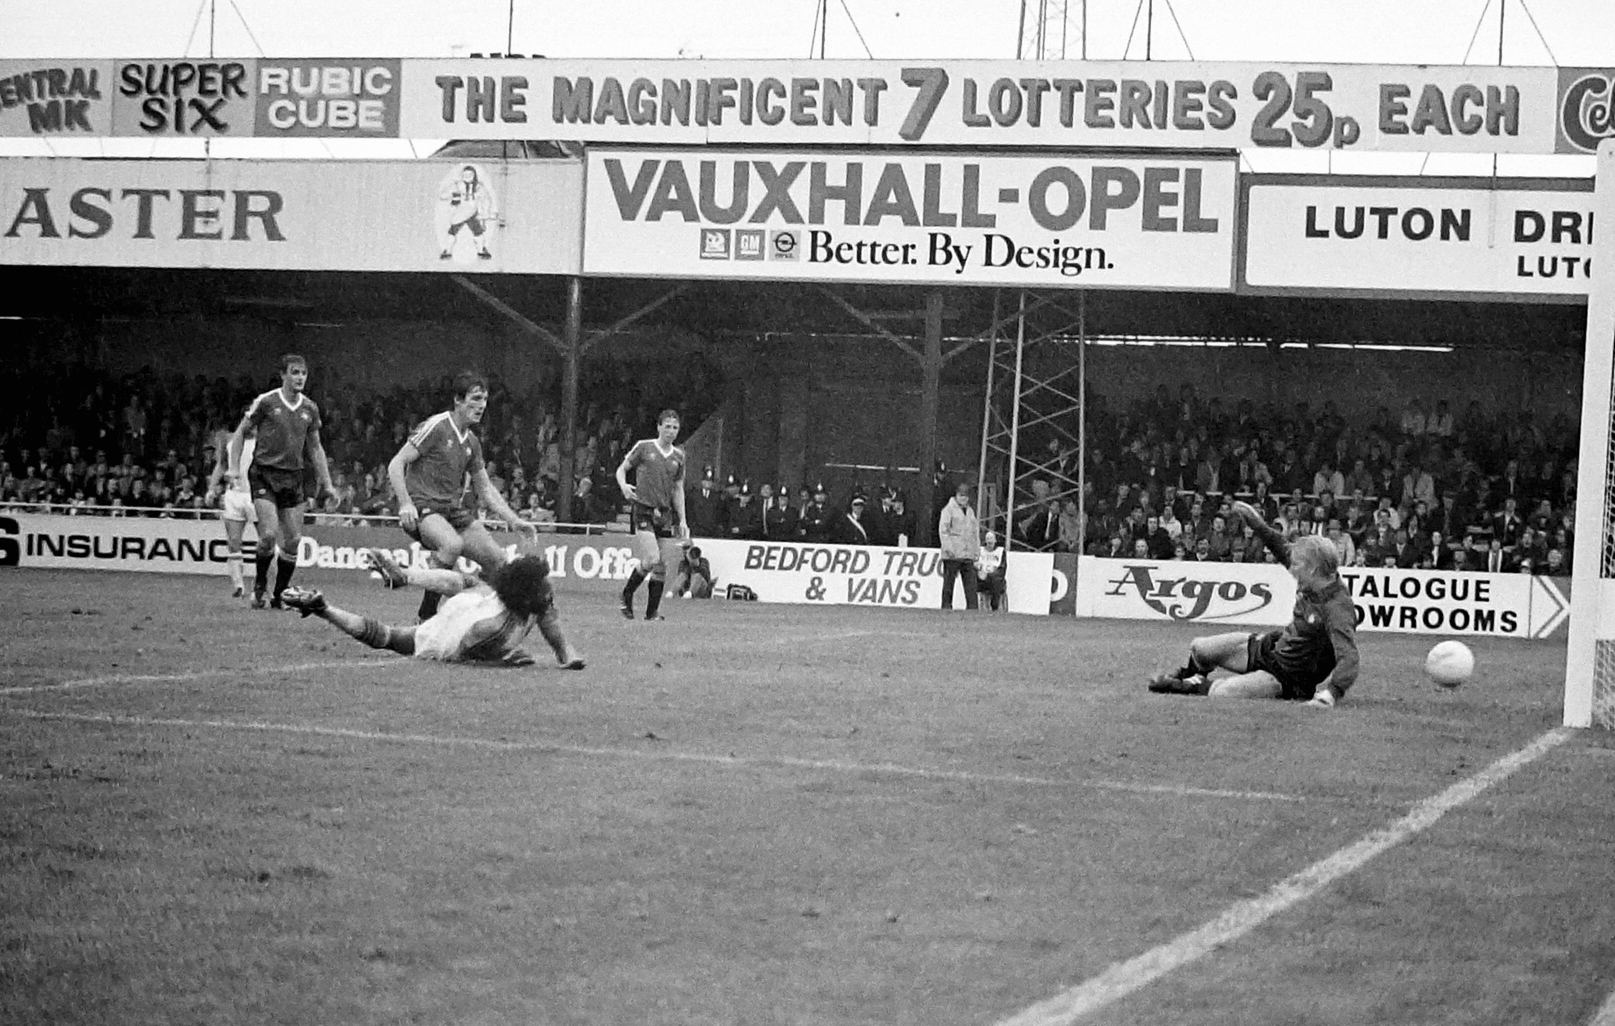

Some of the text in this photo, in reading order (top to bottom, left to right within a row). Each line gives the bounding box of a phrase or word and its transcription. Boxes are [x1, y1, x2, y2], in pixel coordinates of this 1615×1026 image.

[119, 63, 248, 98] SUPER
[260, 66, 393, 98] RUBIC
[27, 100, 93, 133] MK
[139, 98, 230, 133] SIX
[267, 100, 386, 131] CUBE
[435, 67, 1520, 149] THE MAGNIFICENT 7 LOTTERIES 25p EACH
[603, 158, 1219, 233] VAUXHALL-OPEL
[4, 187, 287, 242] ASTER
[1305, 206, 1471, 241] LUTON
[808, 230, 1114, 276] Better. By Design.
[1517, 255, 1591, 279] LUT
[745, 545, 870, 575] BEDFORD
[805, 576, 920, 605] & VANS
[1105, 565, 1273, 621] Argos
